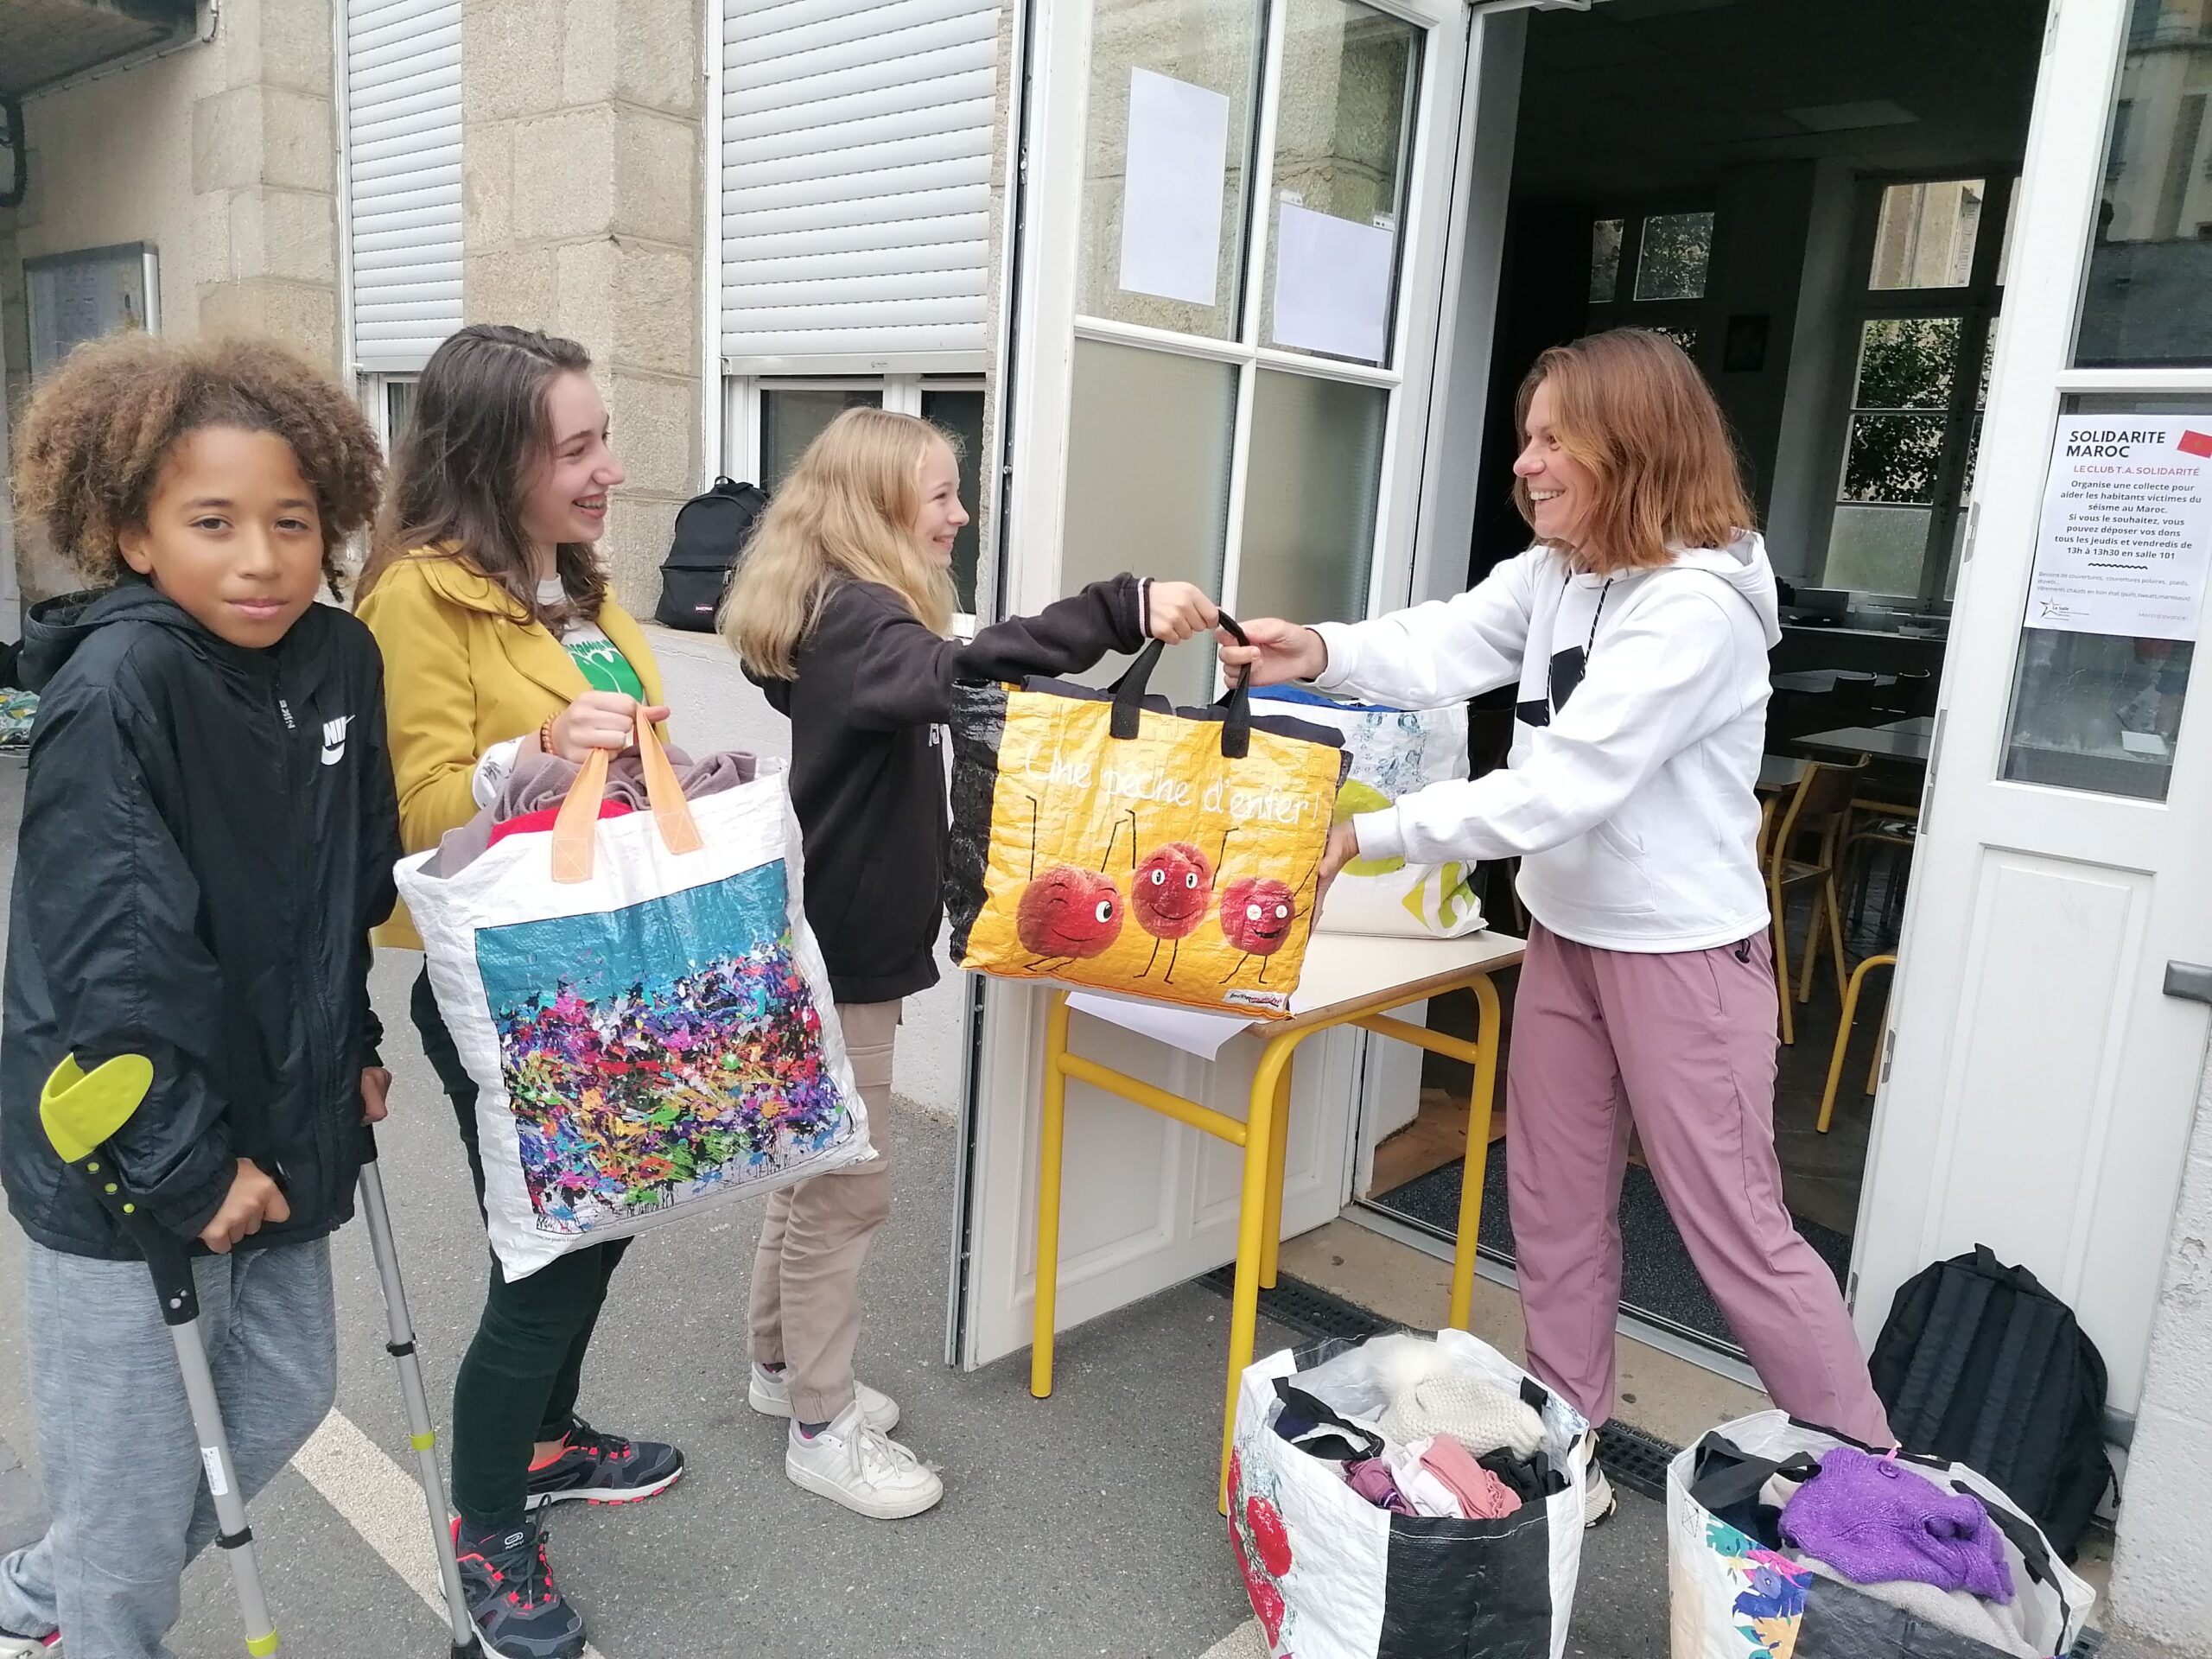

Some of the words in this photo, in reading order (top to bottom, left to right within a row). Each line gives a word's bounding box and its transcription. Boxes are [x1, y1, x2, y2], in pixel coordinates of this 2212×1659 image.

[2069, 430, 2166, 444] SOLIDARITE
[2066, 445, 2131, 458] MAROC
[2087, 465, 2114, 474] CLUB
[2071, 480, 2111, 491] Organise
[2133, 482, 2170, 491] collecte
[2061, 491, 2083, 499] aider
[2101, 492, 2145, 501] habitants
[2147, 494, 2187, 503] victimes
[2190, 495, 2202, 504] du
[2088, 503, 2120, 512] séisme
[2136, 505, 2167, 513] Maroc.
[2102, 514, 2110, 523] le
[2113, 515, 2160, 525] souhaitez,
[2066, 524, 2099, 533] pouvez
[2101, 525, 2138, 537] déposer
[2090, 537, 2118, 546] jeudis
[2133, 539, 2178, 549] vendredis
[2181, 541, 2192, 550] de
[2094, 548, 2120, 556] 13h30
[2135, 550, 2157, 559] salle
[2159, 551, 2175, 560] 101
[279, 699, 296, 728] NIKE
[1025, 741, 1092, 789] Une
[1102, 759, 1192, 807] pêche
